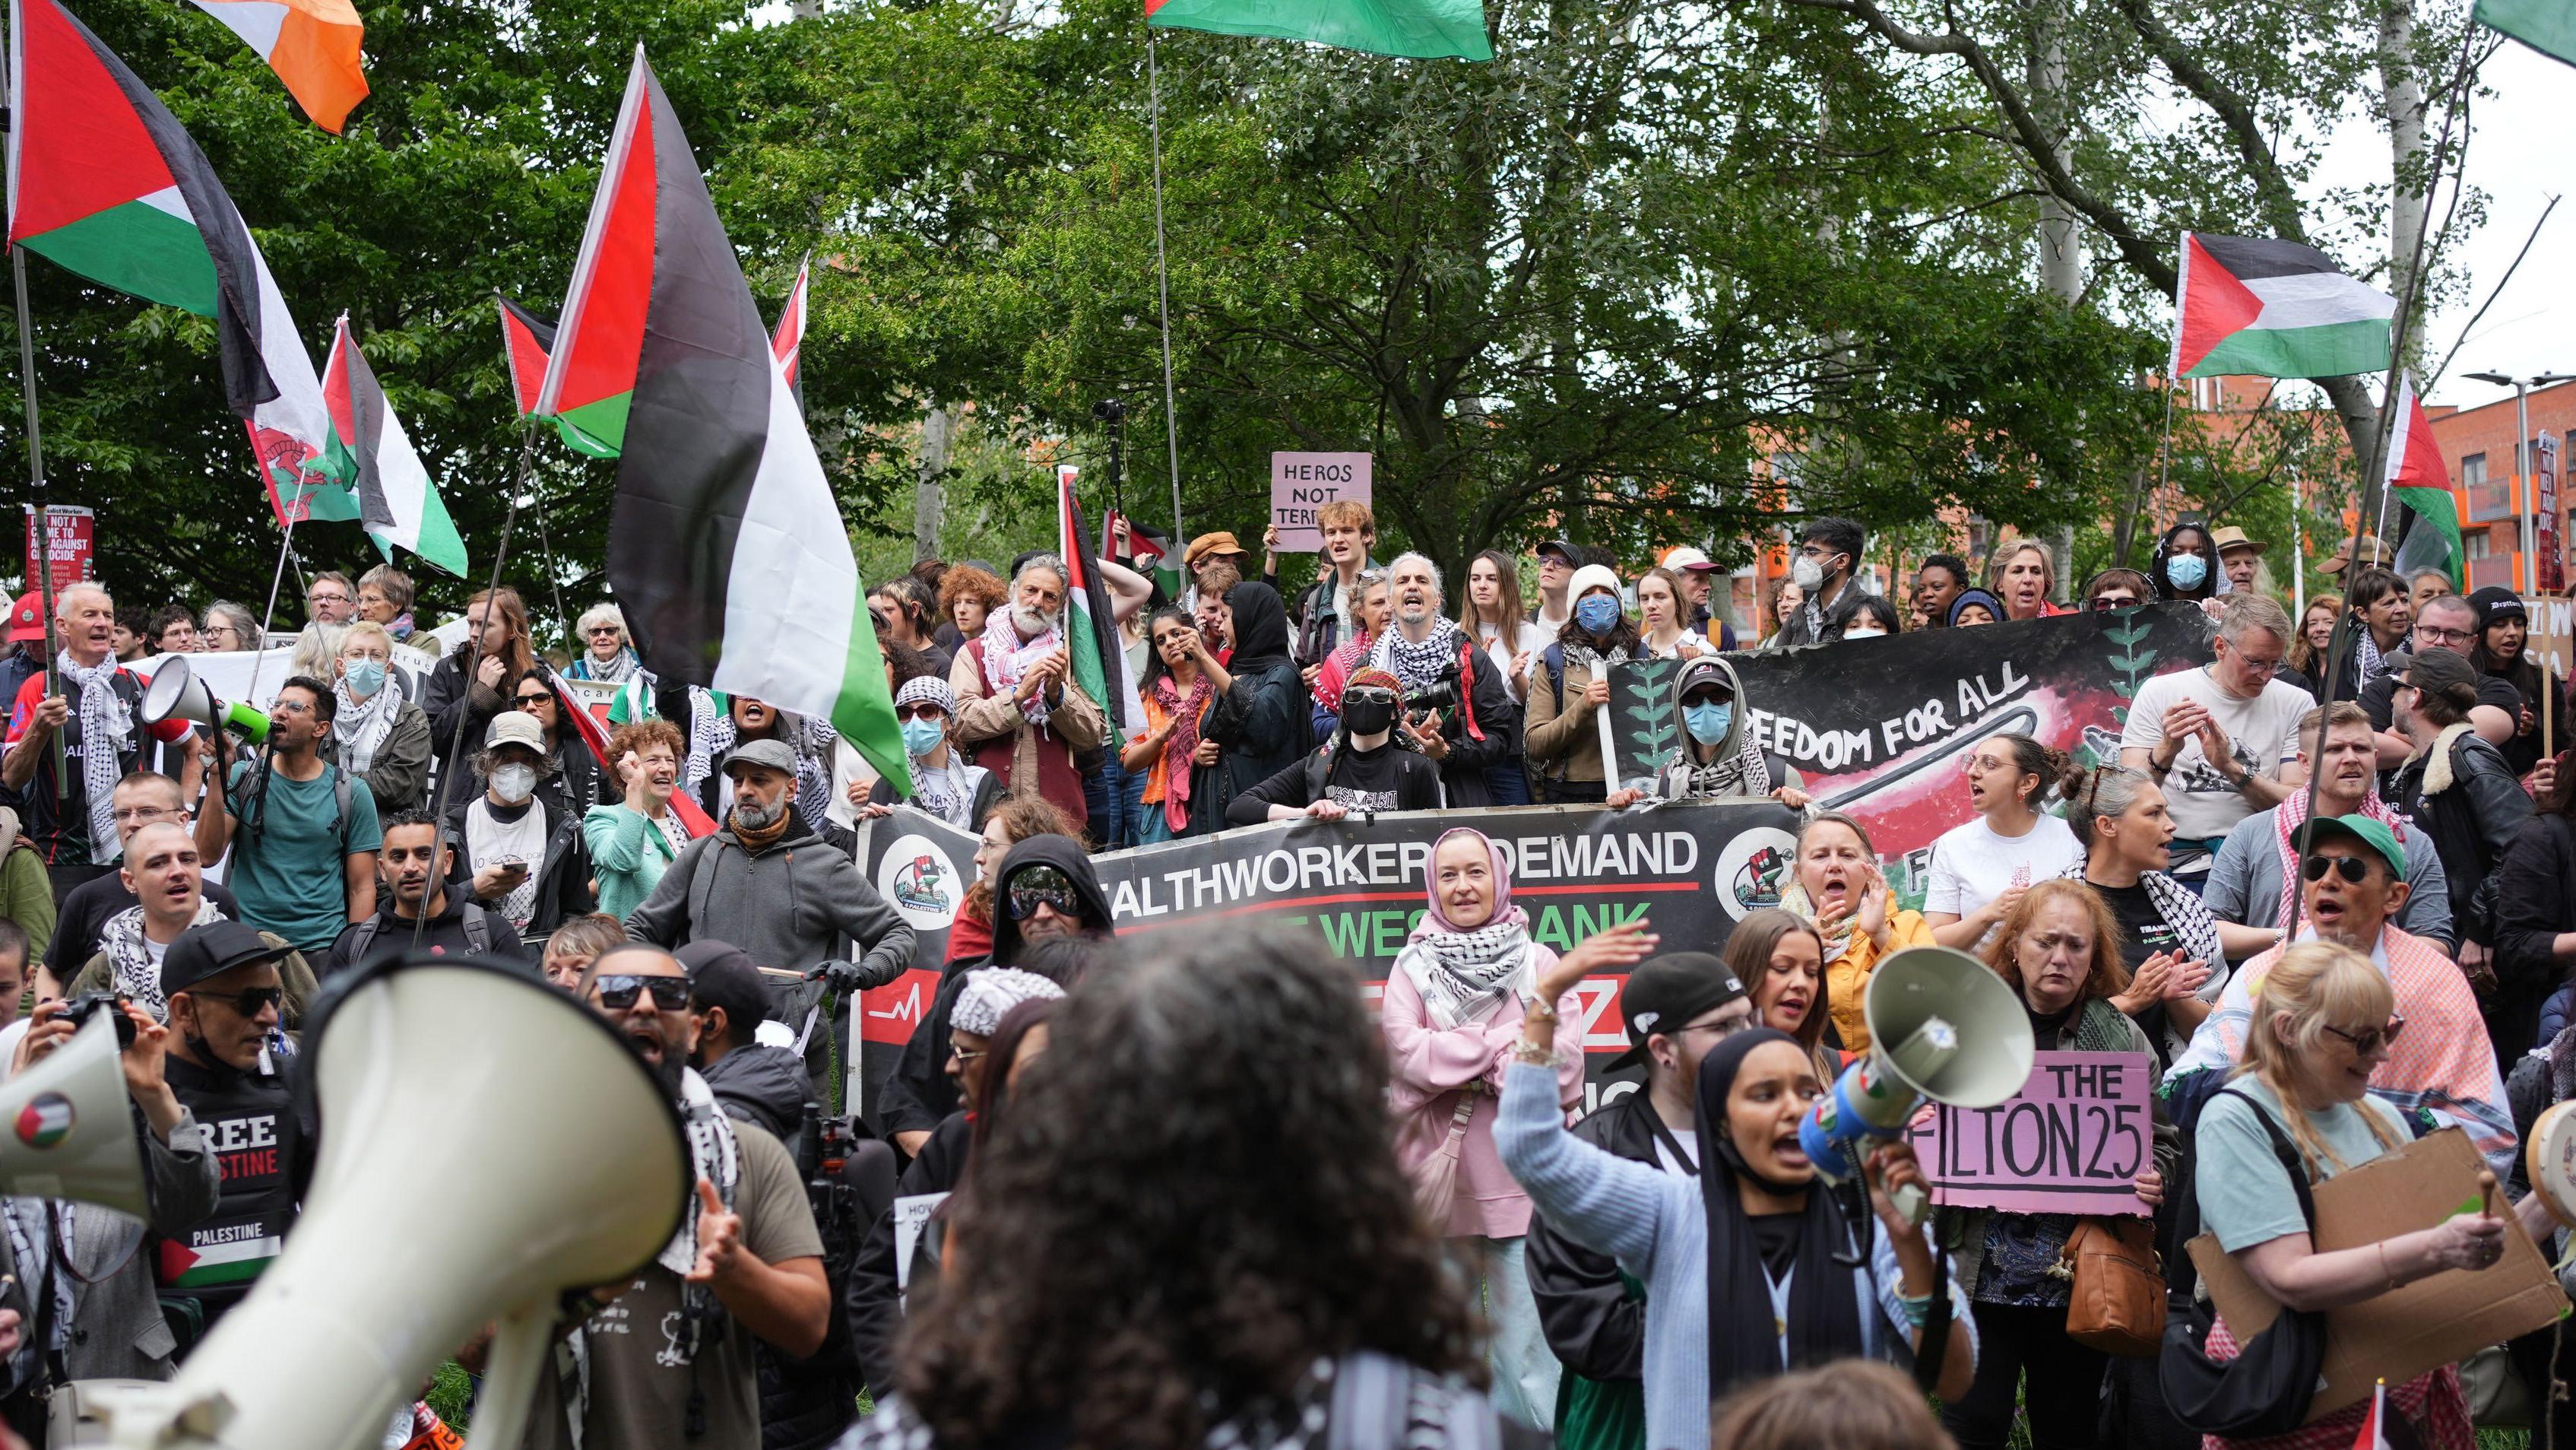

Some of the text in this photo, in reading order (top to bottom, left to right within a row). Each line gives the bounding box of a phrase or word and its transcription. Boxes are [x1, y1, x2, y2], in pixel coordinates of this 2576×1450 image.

[1285, 465, 1352, 483] HEROS
[1293, 488, 1339, 503] NOT
[31, 526, 74, 538] CME TO
[51, 516, 69, 527] NOT
[71, 517, 78, 528] A
[51, 538, 87, 550] AGAINST
[1957, 661, 2030, 717] ALL
[1746, 707, 1872, 769] EEDOM
[1881, 698, 1956, 756] FOR
[909, 904, 941, 913] PALESTINE
[2045, 1064, 2123, 1099] THE
[197, 1115, 277, 1153] REE
[219, 1150, 279, 1180] STINE
[193, 1223, 264, 1246] PALESTINE
